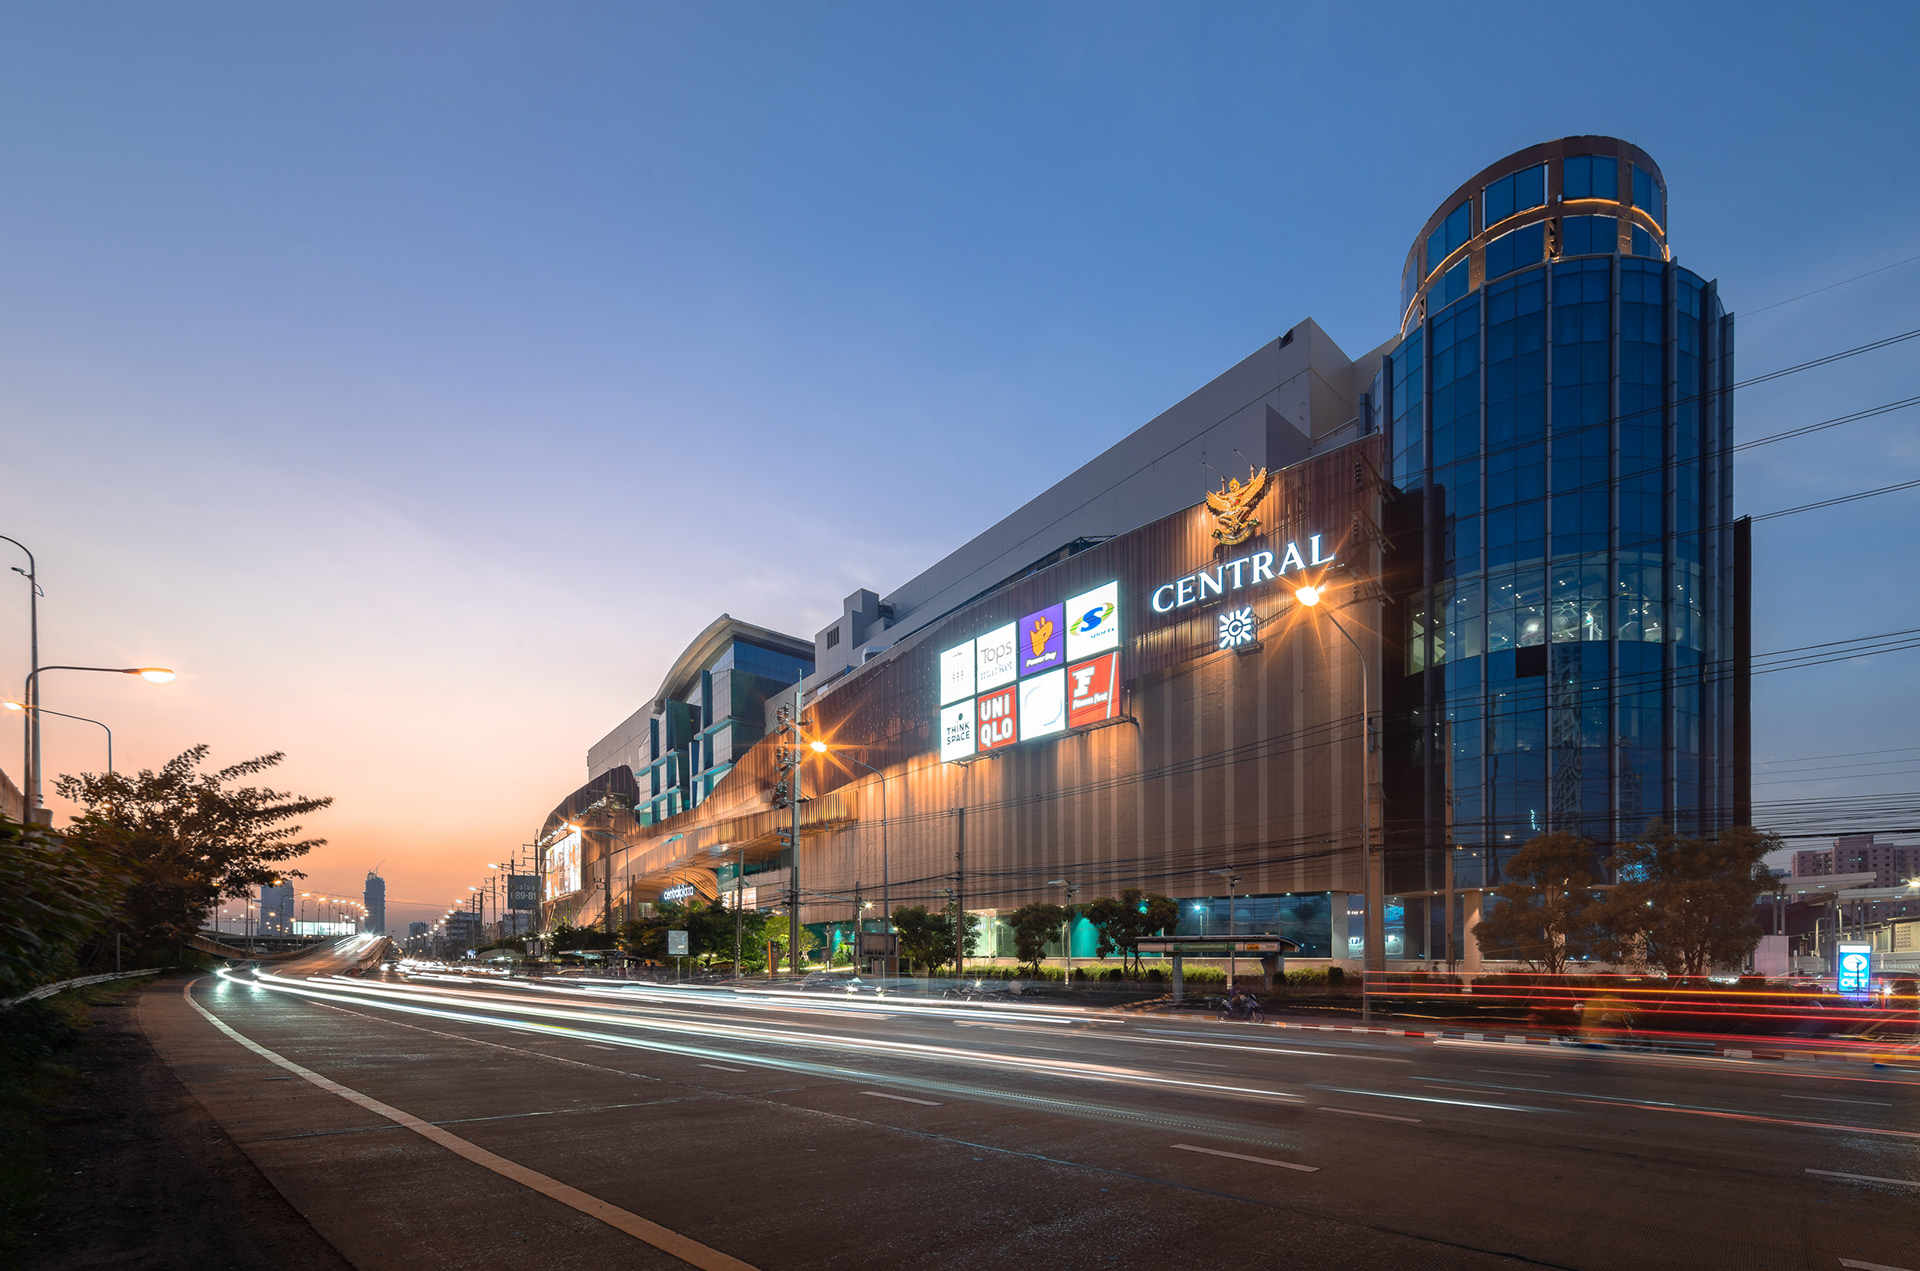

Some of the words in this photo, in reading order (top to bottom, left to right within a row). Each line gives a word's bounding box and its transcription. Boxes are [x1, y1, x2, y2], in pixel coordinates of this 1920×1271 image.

[1151, 534, 1336, 613] CENTRAL
[980, 641, 1012, 664] Tops
[980, 693, 1010, 721] UNI
[946, 721, 970, 736] THINK
[946, 730, 970, 745] SPACE
[980, 717, 1013, 747] QLO
[1840, 978, 1868, 988] OUT
